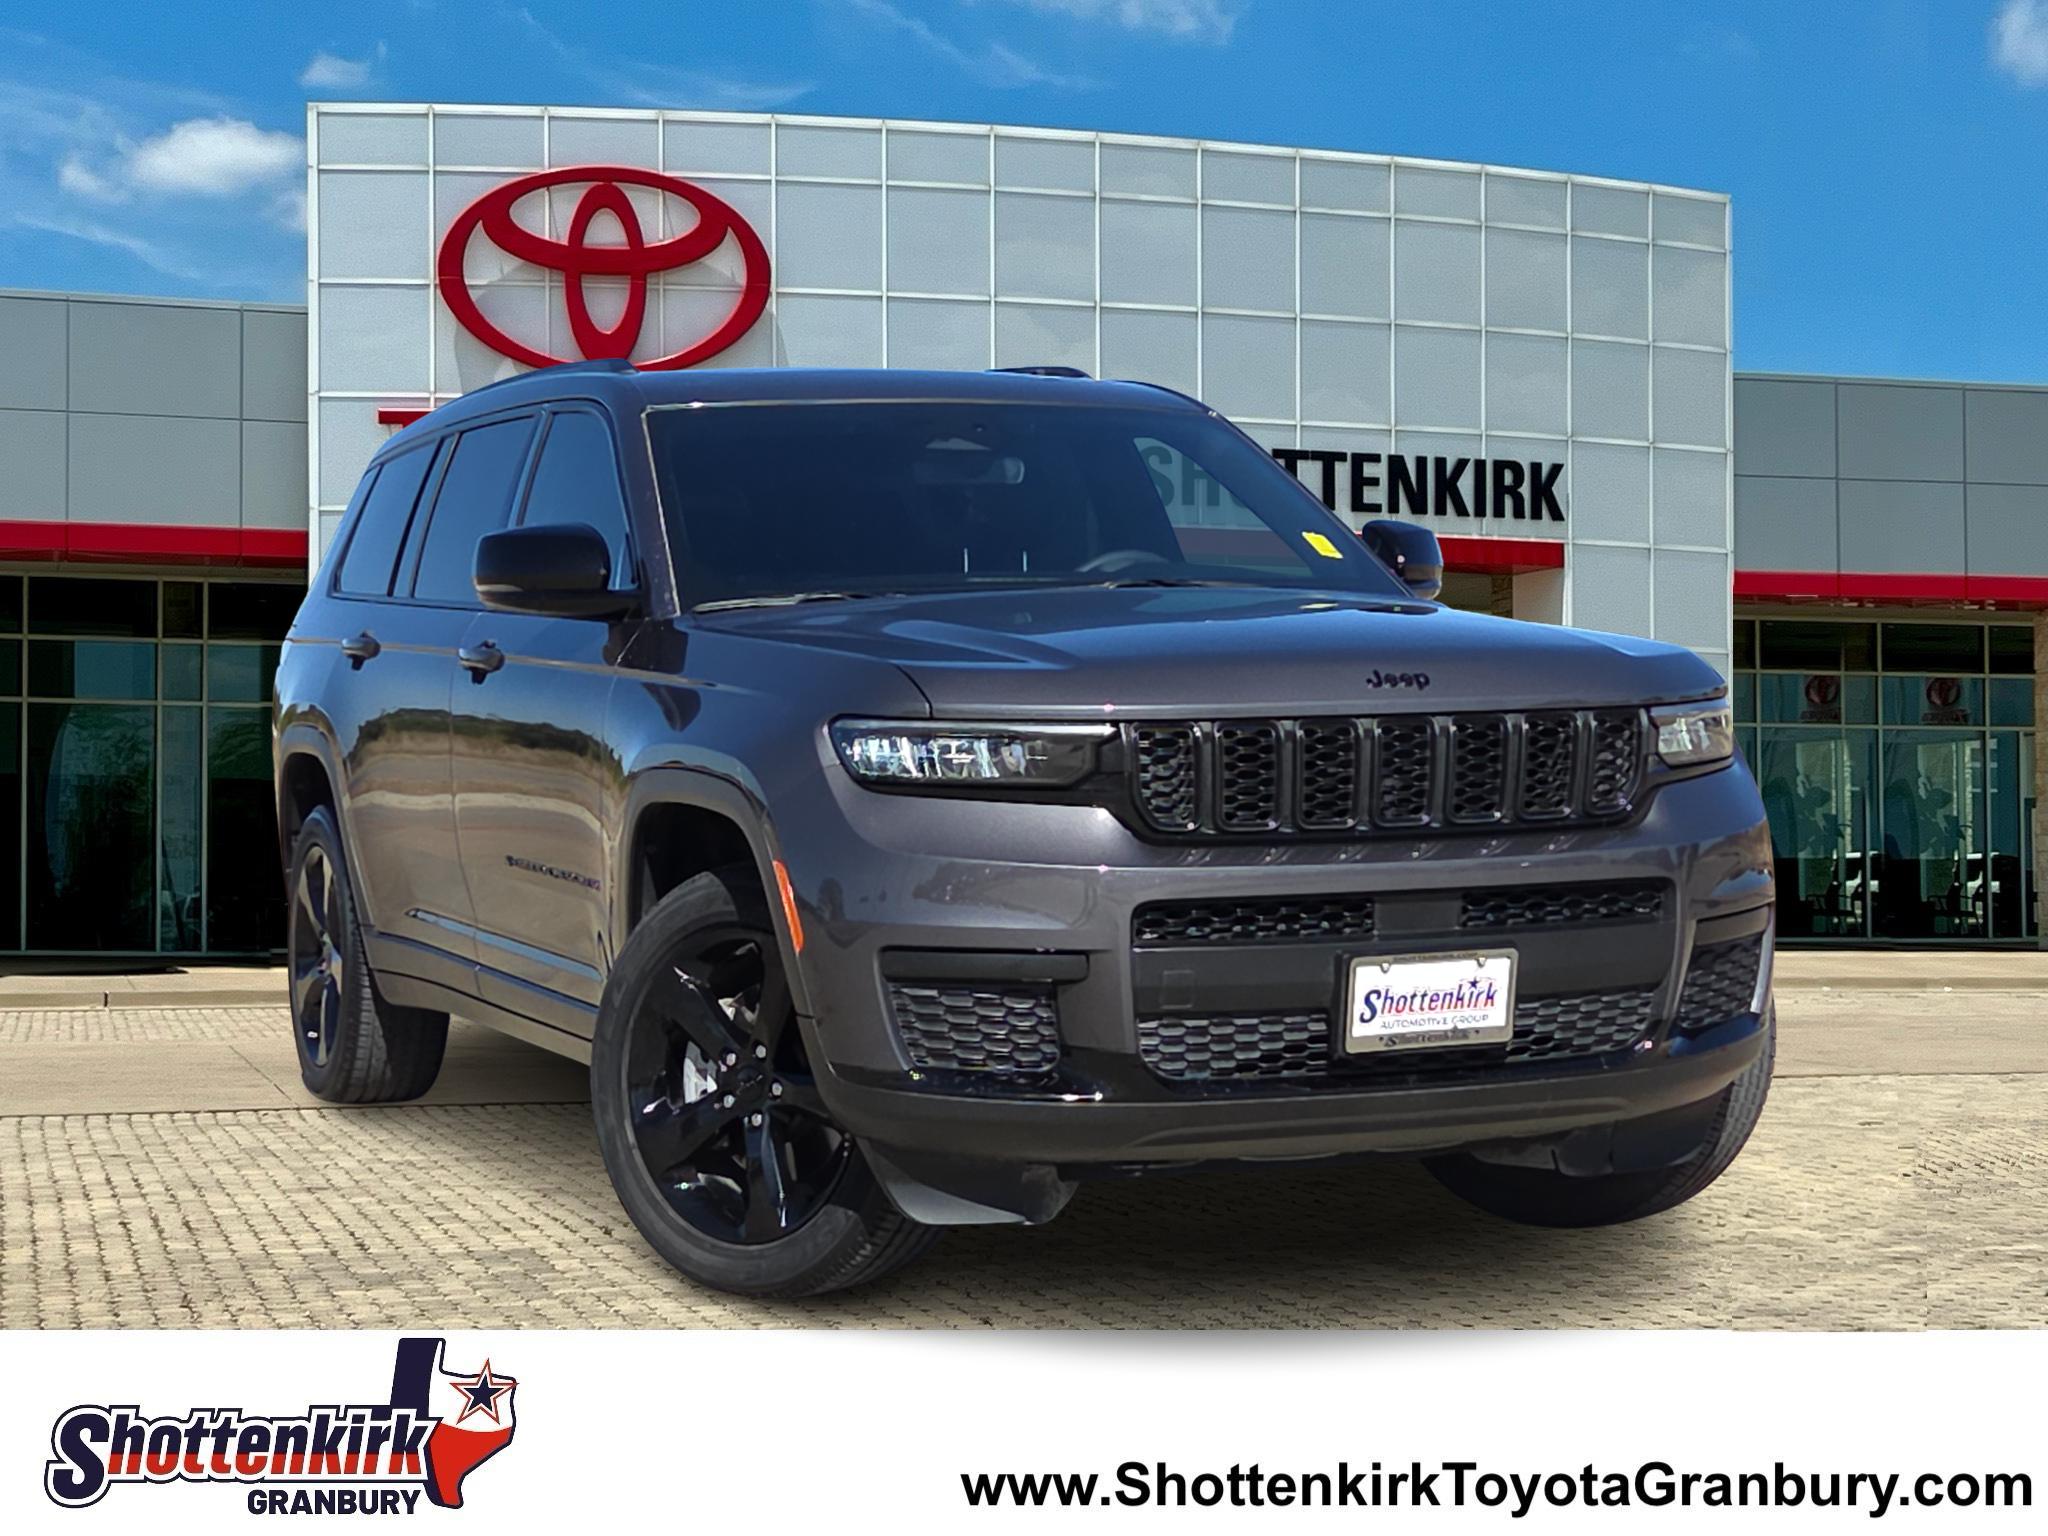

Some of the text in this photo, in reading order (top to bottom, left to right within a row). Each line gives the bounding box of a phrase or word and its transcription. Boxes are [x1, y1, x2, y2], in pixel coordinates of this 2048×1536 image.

[1140, 446, 1565, 521] SHTTENKIRK
[1366, 669, 1430, 691] Jeep
[1359, 982, 1497, 1023] Shottenkirk
[1381, 1014, 1489, 1030] AUTOMOTIVE GROUP
